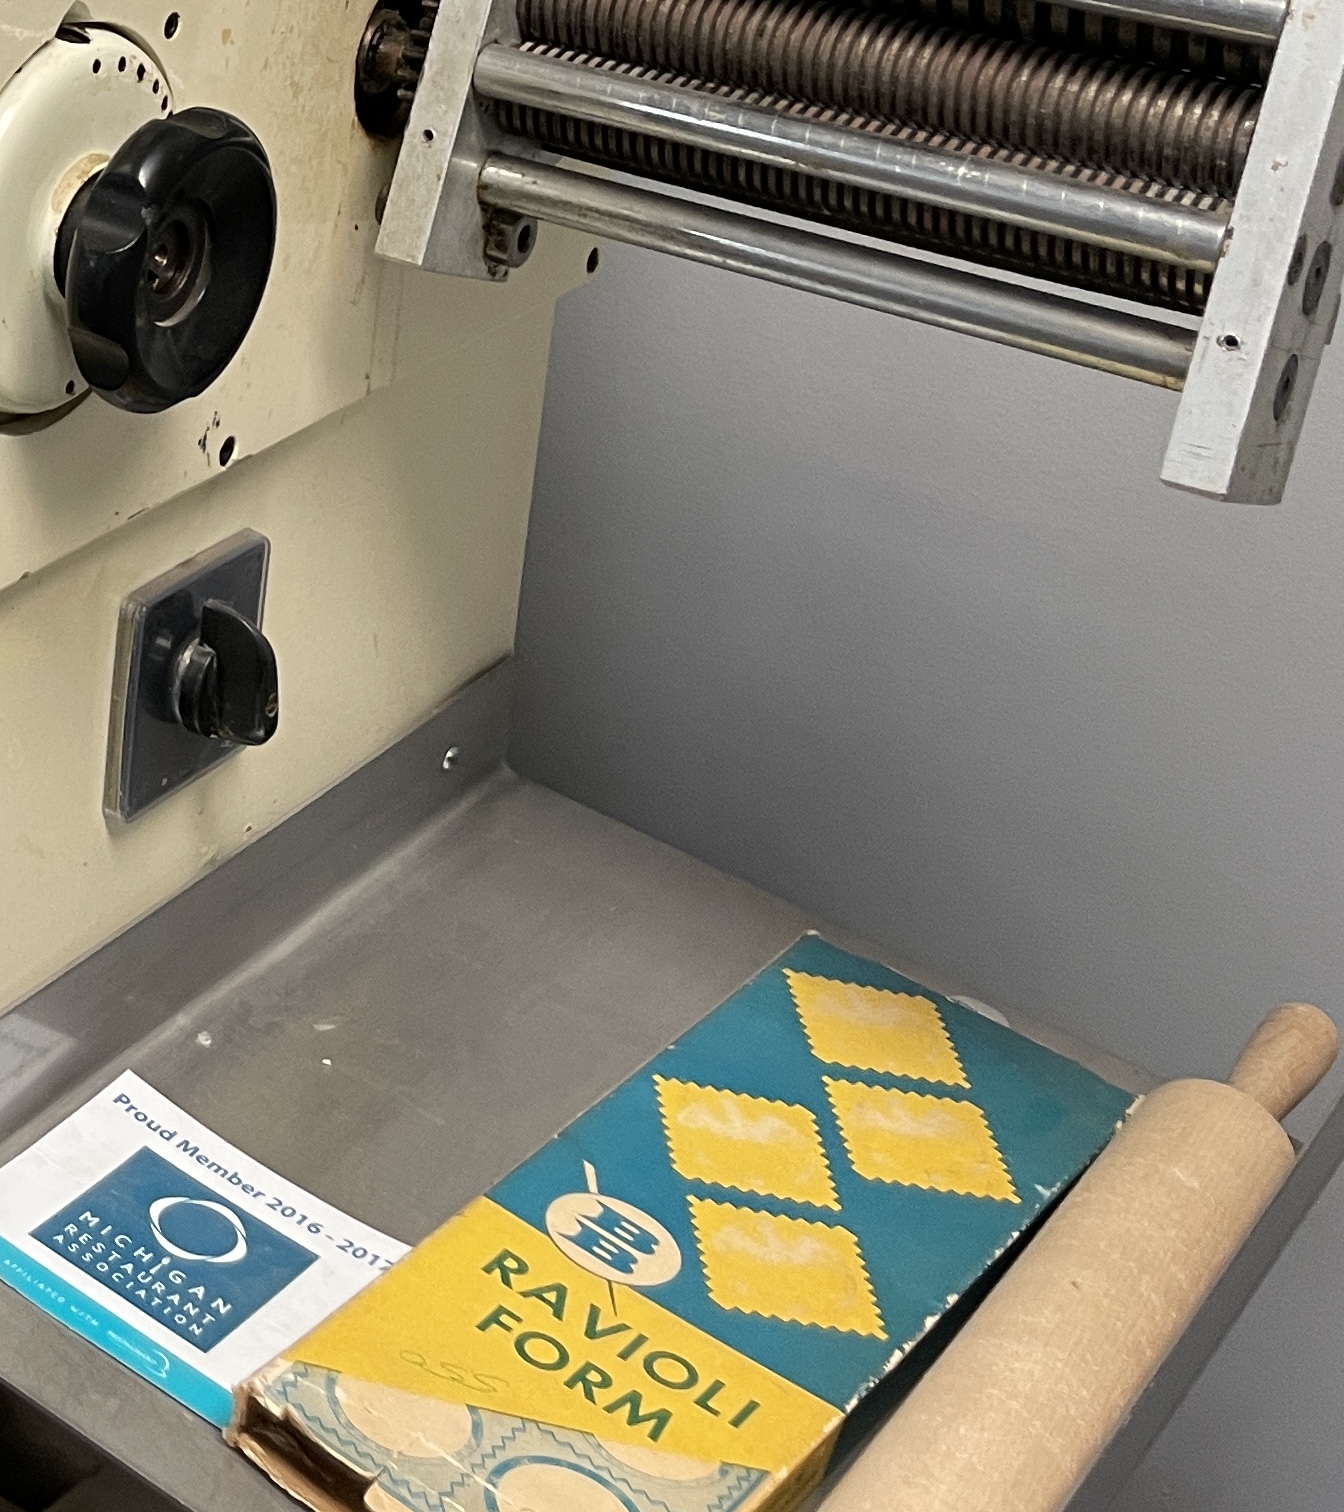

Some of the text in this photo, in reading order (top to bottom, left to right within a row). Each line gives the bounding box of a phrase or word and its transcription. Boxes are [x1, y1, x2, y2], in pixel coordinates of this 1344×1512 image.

[112, 1092, 178, 1144] Proud
[177, 1135, 265, 1203] Member
[265, 1192, 324, 1238] 2016
[3, 1259, 100, 1327] AFFILIATED WITH
[52, 1233, 205, 1337] ASSOCIATION
[63, 1222, 218, 1327] RESTAURANT
[78, 1210, 233, 1318] MICHIGAN
[474, 1302, 677, 1446] FORM
[479, 1245, 763, 1433] RAVIOLI
